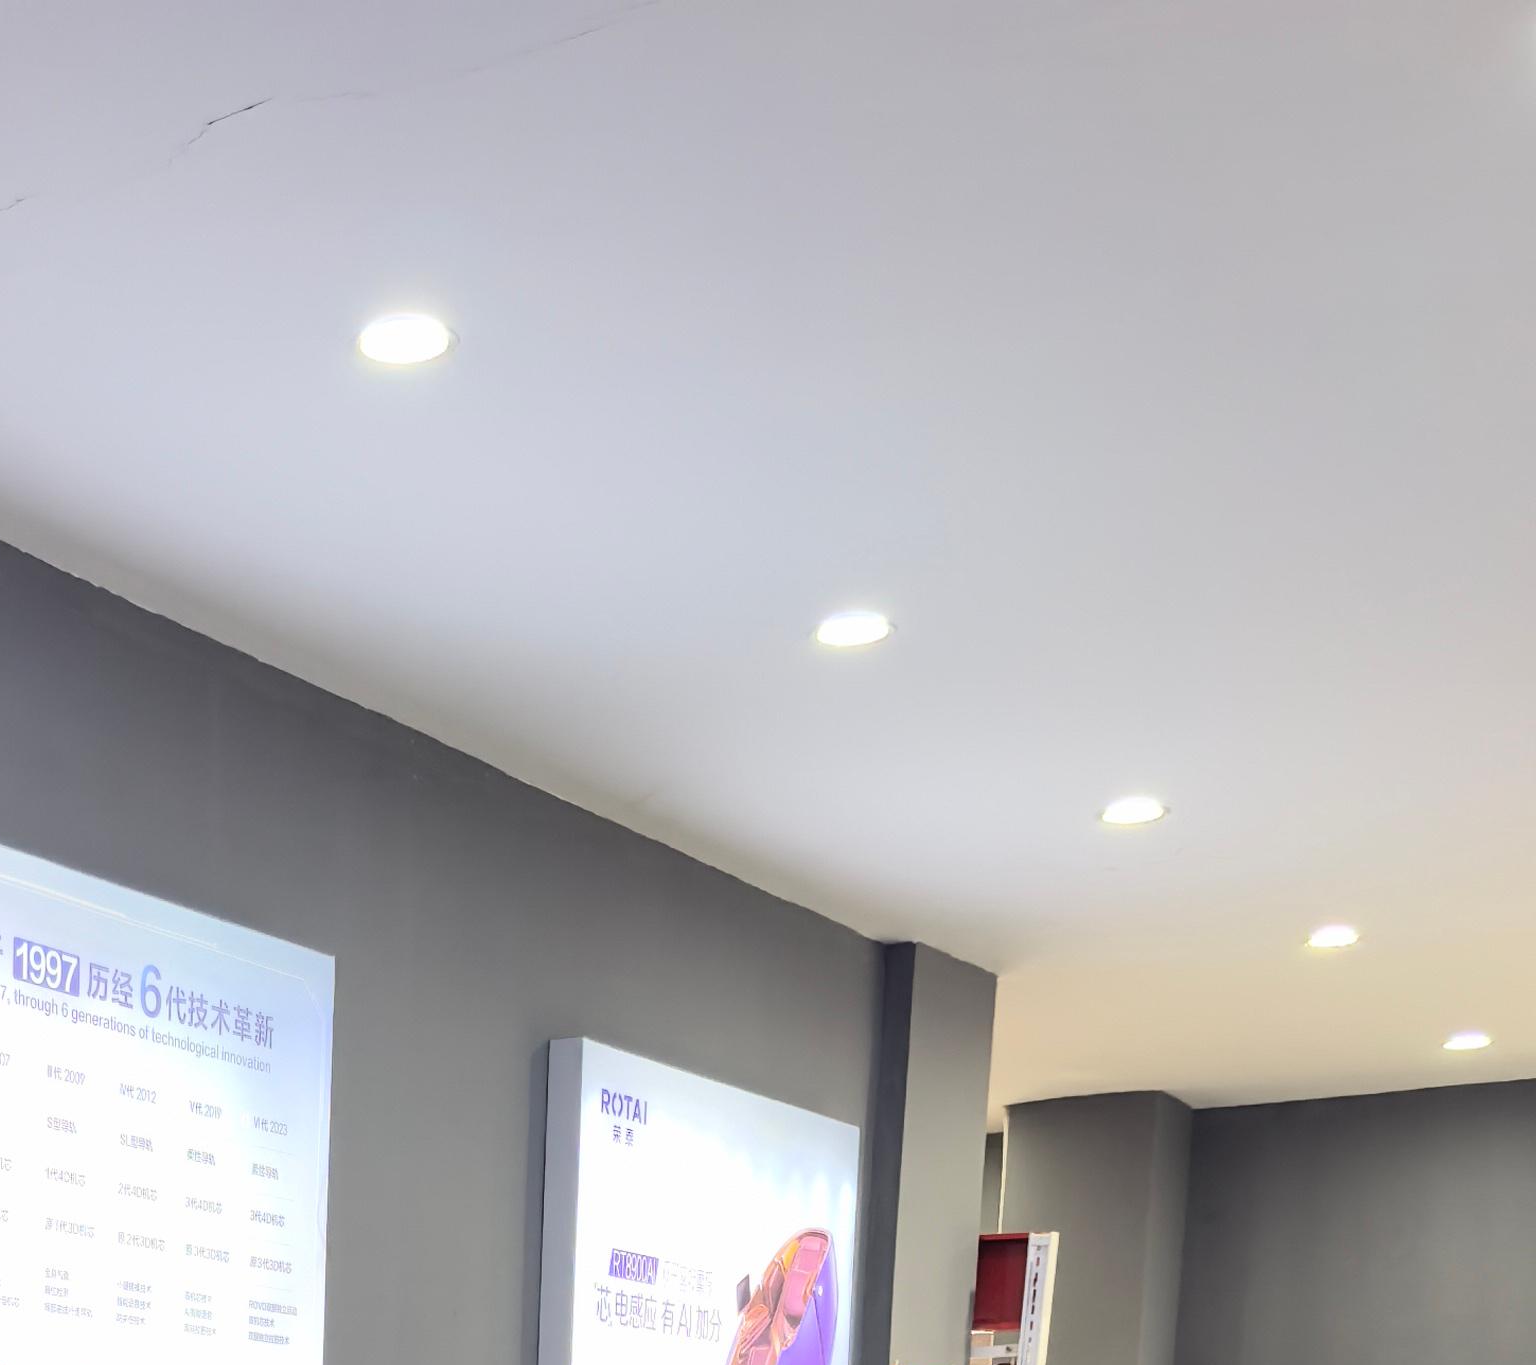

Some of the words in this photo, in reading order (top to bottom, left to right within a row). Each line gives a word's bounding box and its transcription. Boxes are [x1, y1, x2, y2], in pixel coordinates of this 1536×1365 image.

[16, 942, 79, 994] 1997
[14, 988, 58, 1017] through
[61, 1002, 69, 1017] 6
[71, 1009, 136, 1037] generations
[138, 1024, 150, 1040] of
[152, 1027, 219, 1057] technological
[221, 1045, 272, 1073] innovation
[601, 1088, 647, 1125] ROTAI
